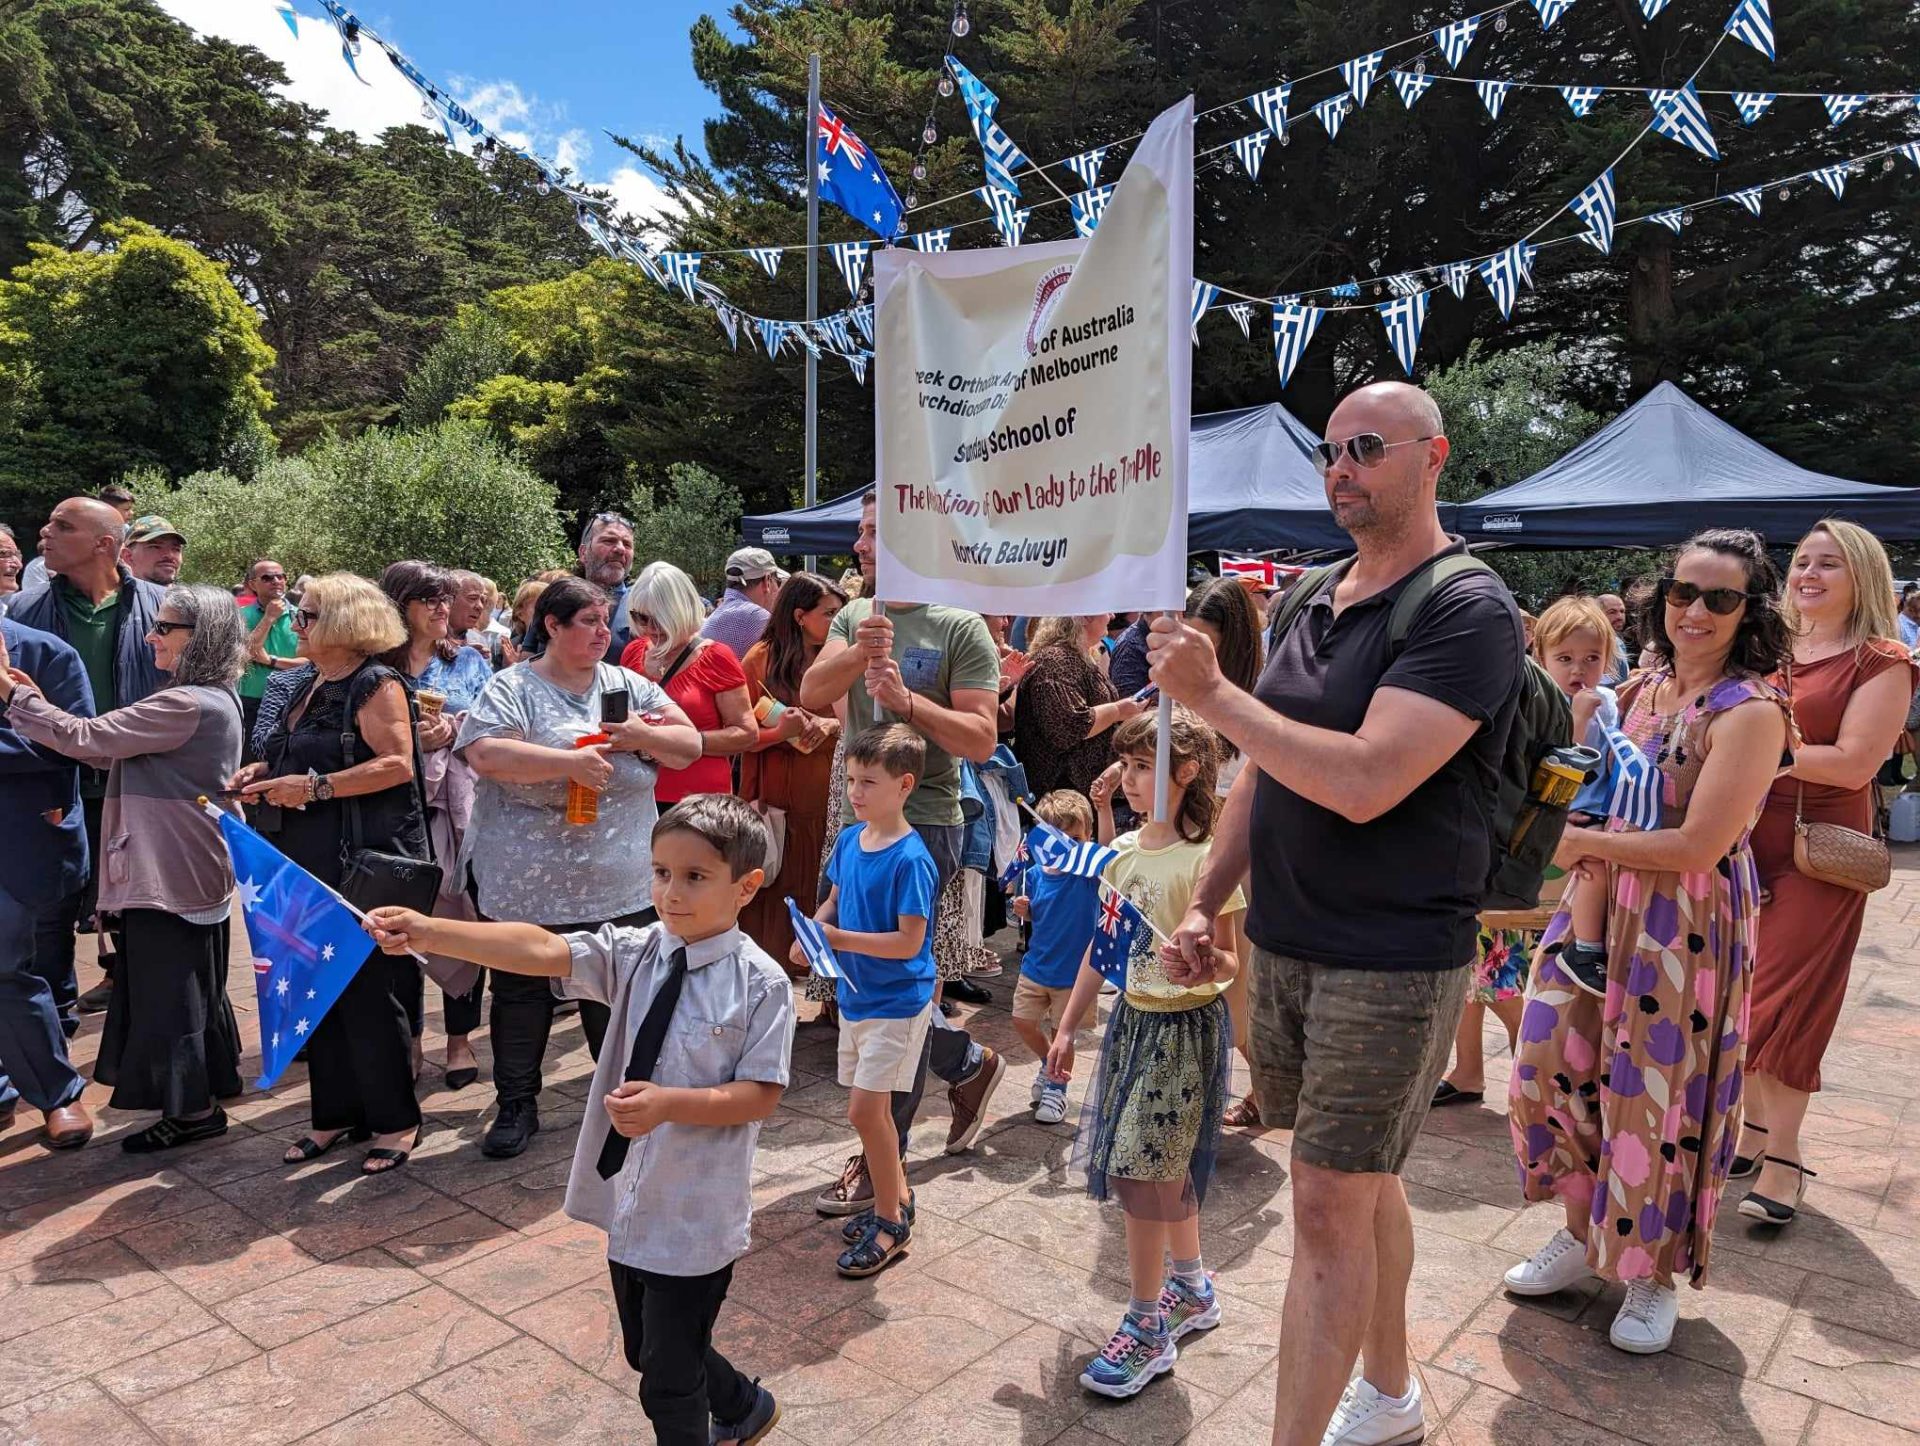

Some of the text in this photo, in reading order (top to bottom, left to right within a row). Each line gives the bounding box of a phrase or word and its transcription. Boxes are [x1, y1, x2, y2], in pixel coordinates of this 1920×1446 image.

[915, 369, 945, 387] reek
[1041, 328, 1058, 353] of
[1062, 304, 1135, 347] Australia
[1014, 369, 1028, 392] of
[1030, 344, 1118, 386] Melbourne
[988, 415, 1051, 454] School
[1054, 407, 1077, 437] of
[894, 484, 925, 514] The
[992, 490, 1022, 514] Our
[1024, 473, 1064, 510] Lady
[1069, 470, 1085, 502] to
[1089, 462, 1117, 497] the
[951, 537, 1067, 567] North Balwyn
